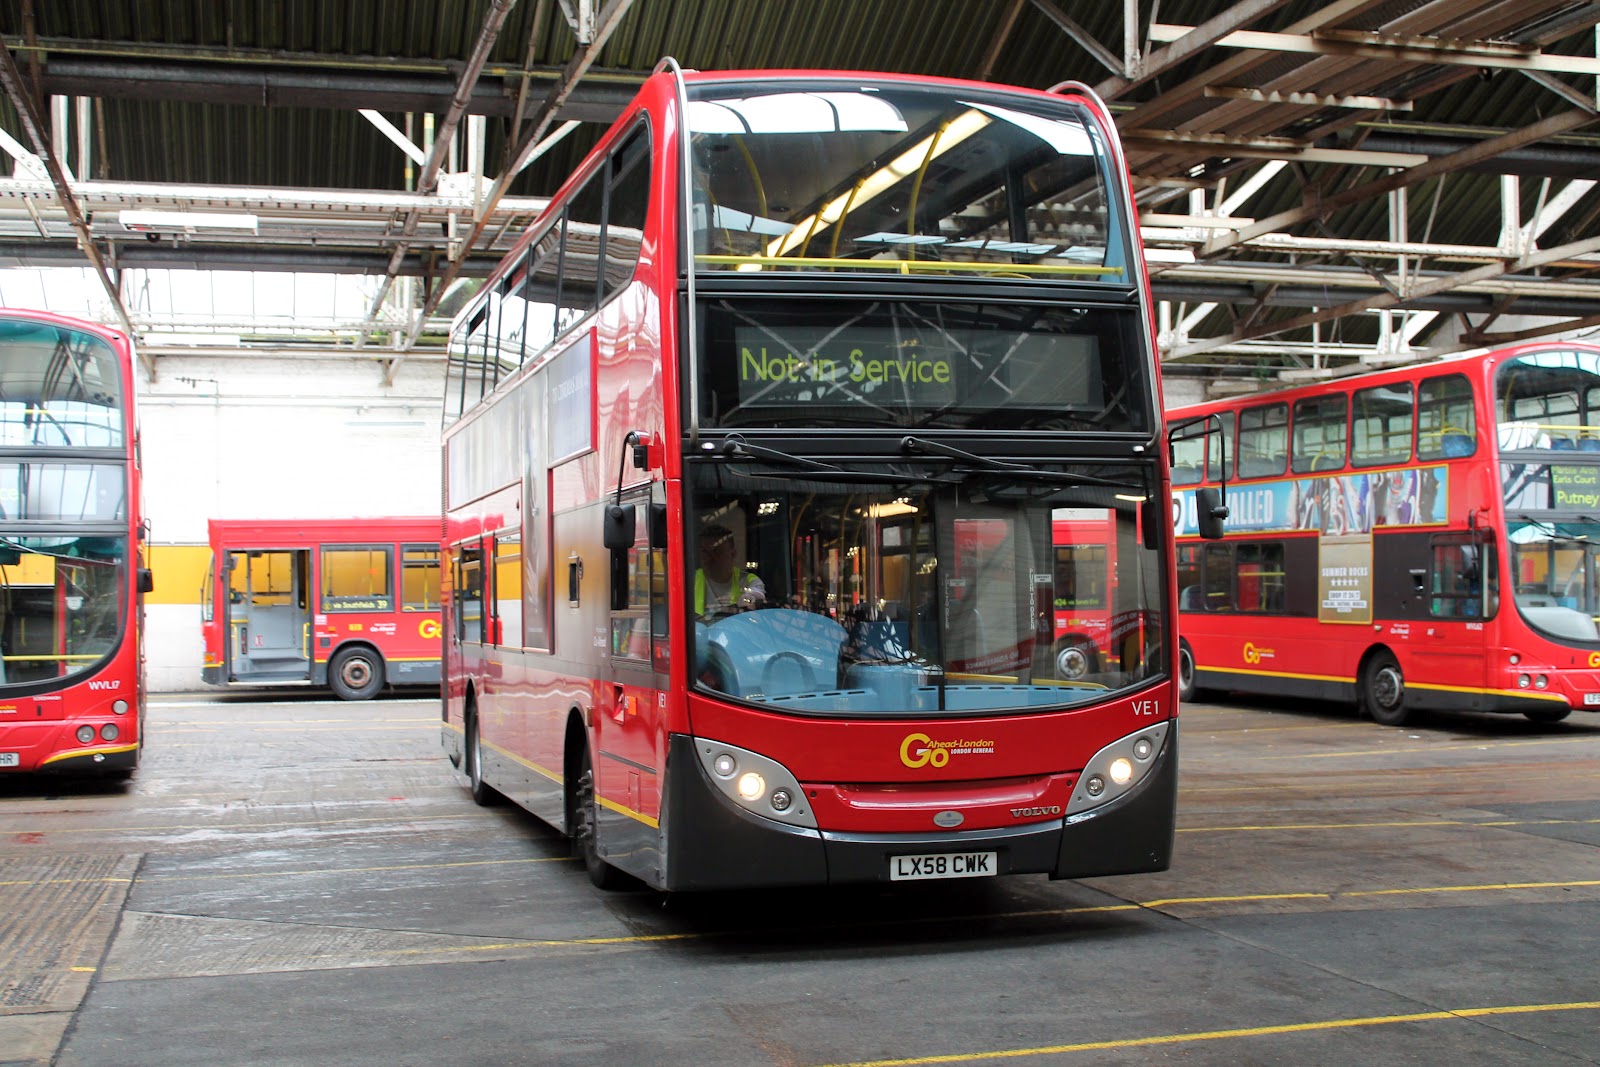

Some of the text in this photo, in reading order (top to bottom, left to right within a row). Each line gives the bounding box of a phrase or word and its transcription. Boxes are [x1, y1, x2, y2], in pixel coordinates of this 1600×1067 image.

[741, 348, 950, 383] Not in Service
[1553, 474, 1597, 485] Earls Court
[1556, 490, 1600, 508] Putney
[1322, 567, 1347, 577] SUMMER
[376, 599, 388, 609] 39
[88, 680, 121, 690] WVL17
[1131, 700, 1159, 716] VE1
[900, 733, 994, 769] Go Ahead-London
[1010, 805, 1061, 818] VOLVO
[898, 854, 989, 876] LX58 CWK
